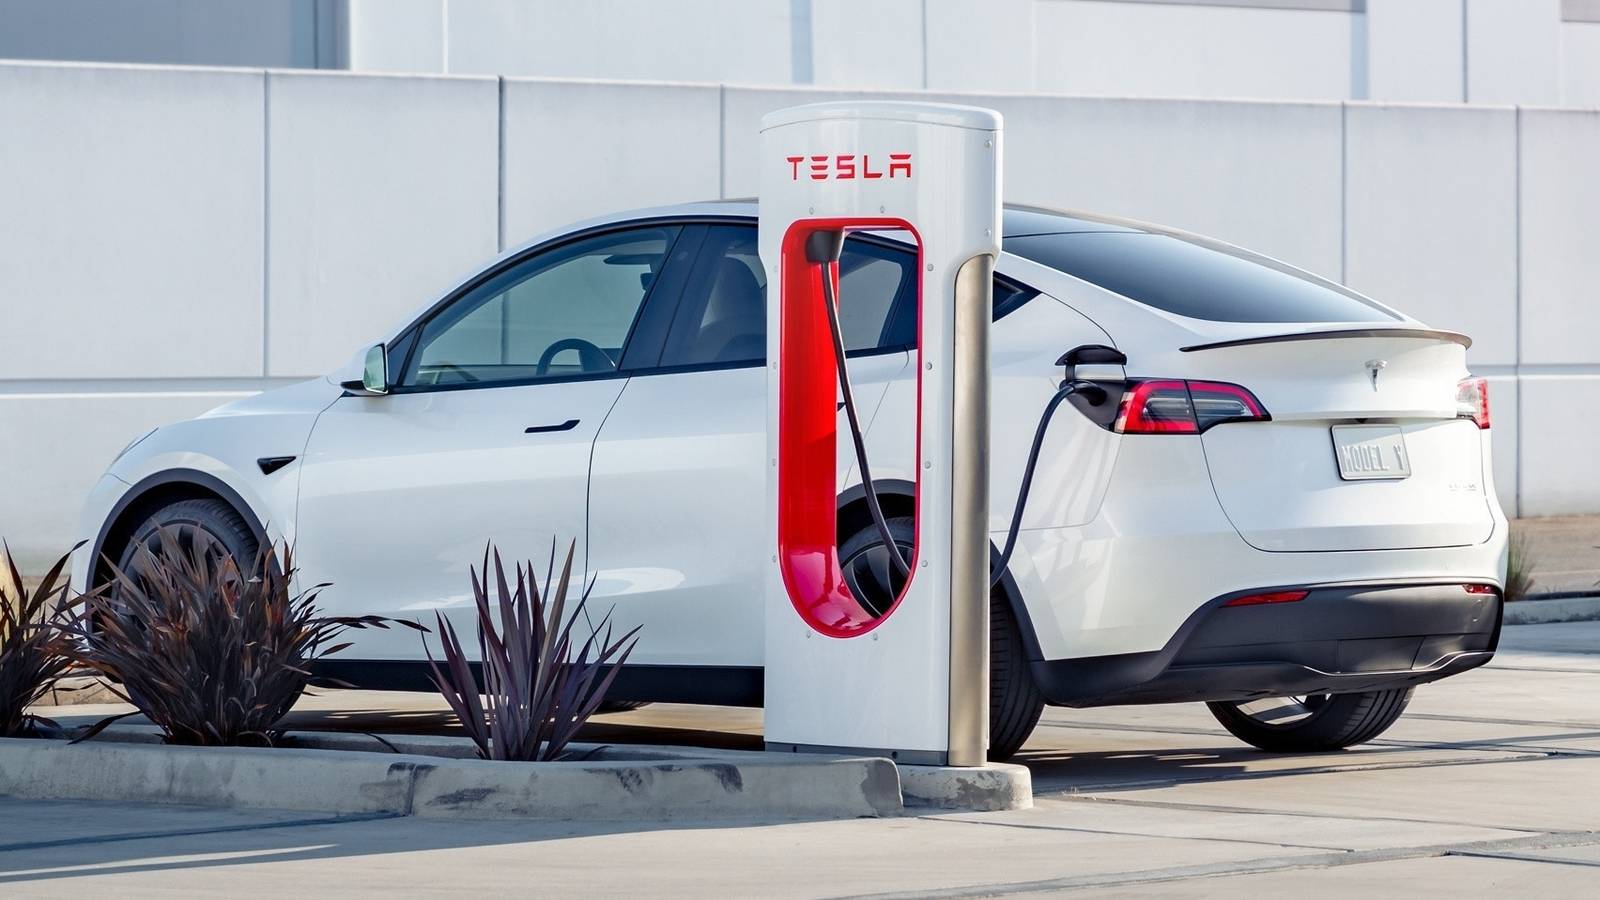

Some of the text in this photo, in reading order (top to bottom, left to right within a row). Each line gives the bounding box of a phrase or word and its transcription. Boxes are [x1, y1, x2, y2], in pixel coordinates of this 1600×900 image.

[786, 154, 912, 180] TESLA
[1340, 444, 1404, 472] MODEL Y
